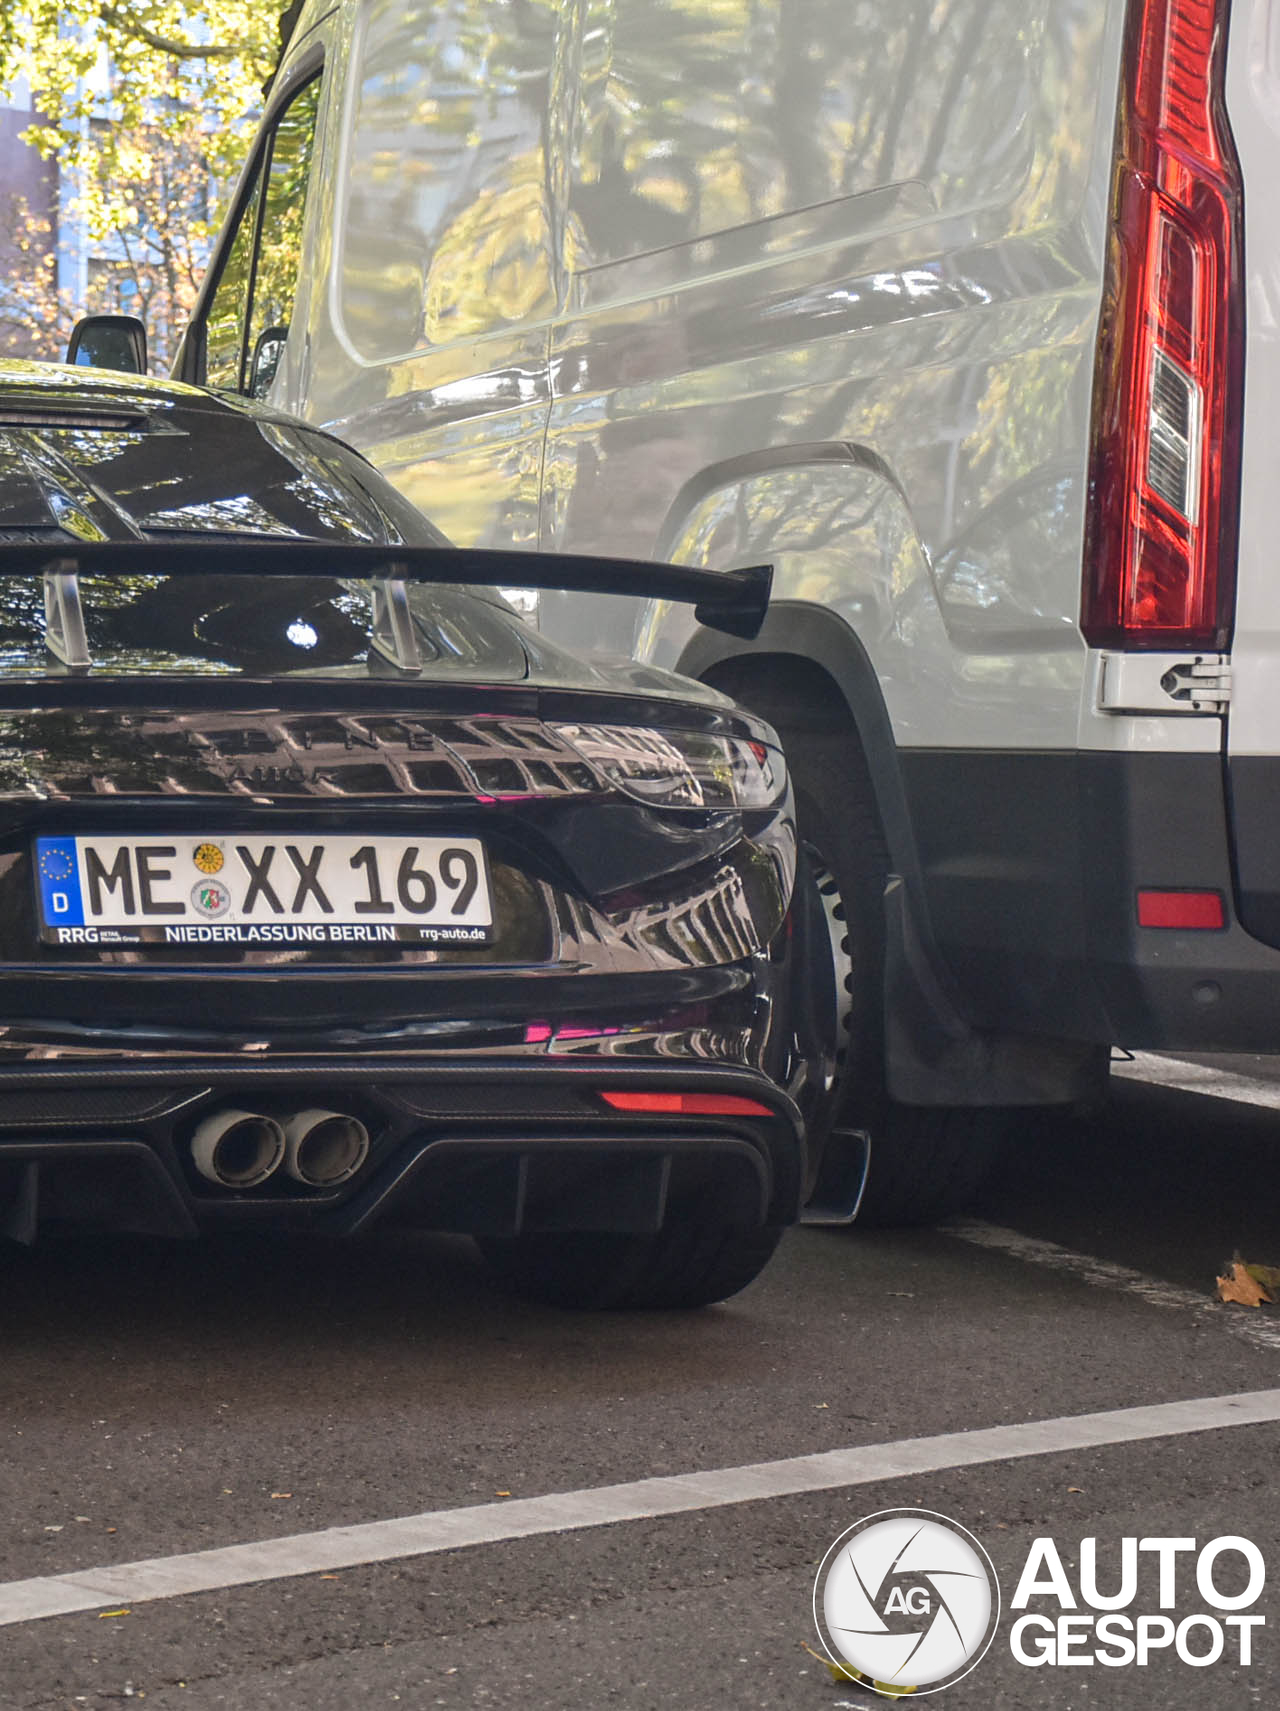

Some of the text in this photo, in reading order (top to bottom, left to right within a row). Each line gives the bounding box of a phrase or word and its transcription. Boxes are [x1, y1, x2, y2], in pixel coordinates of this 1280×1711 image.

[84, 846, 186, 915] ME
[234, 845, 335, 915] XX
[349, 846, 478, 915] 169
[53, 892, 69, 912] D
[57, 927, 99, 943] RRG
[165, 925, 397, 942] NIEDERLASSUNG BERLIN
[419, 927, 486, 942] rrg-auto.de
